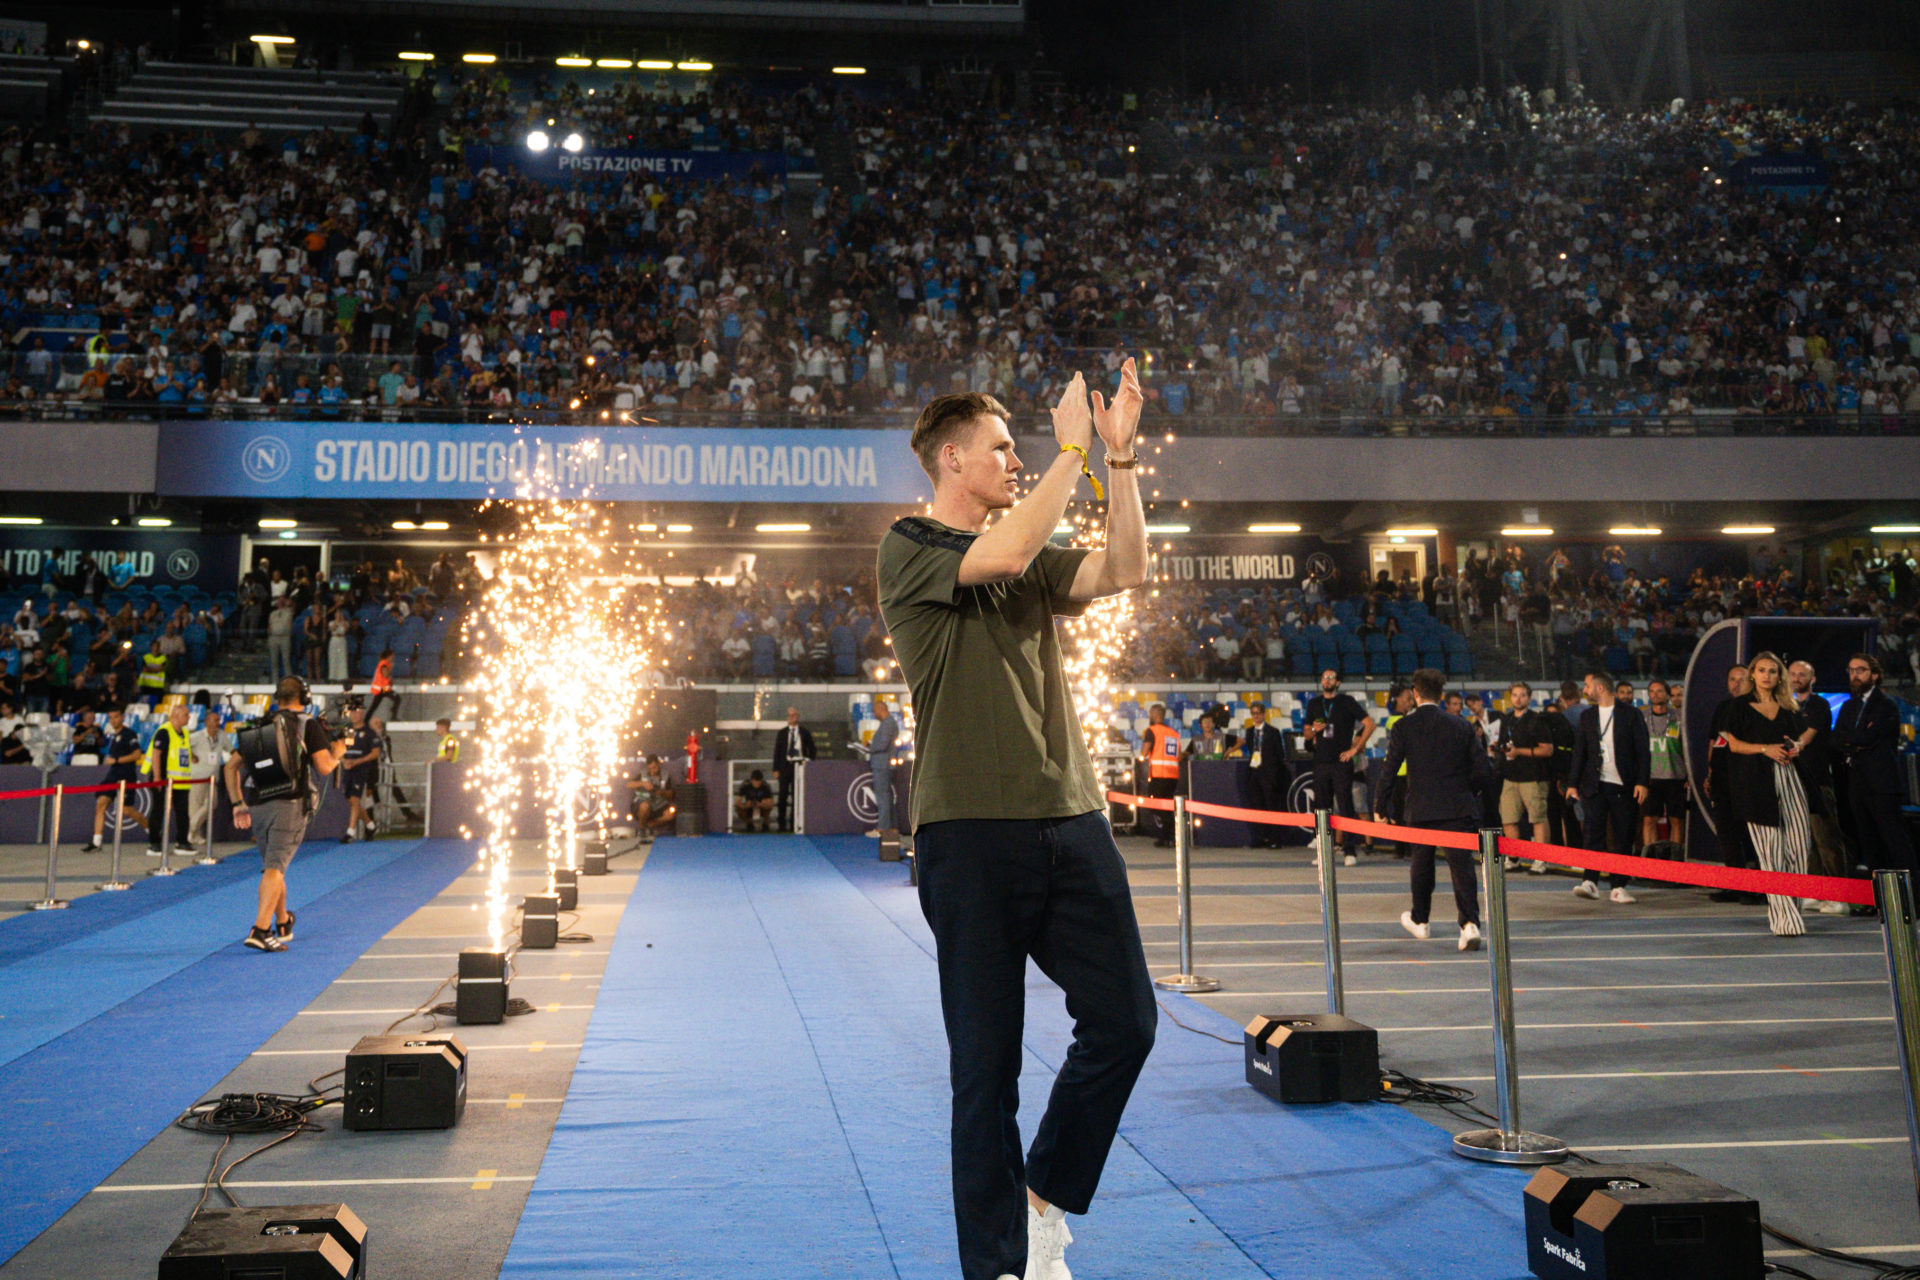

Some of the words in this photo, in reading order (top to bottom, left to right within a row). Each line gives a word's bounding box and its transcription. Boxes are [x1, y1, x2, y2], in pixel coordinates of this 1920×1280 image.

[558, 156, 666, 172] POSTAZIONE
[670, 158, 692, 173] TV
[257, 448, 276, 470] N
[315, 440, 430, 482] STADIO
[437, 441, 529, 484] DIEGO
[534, 443, 693, 486] ARMANDO
[700, 445, 877, 487] MARADONA
[14, 549, 41, 576] TO
[91, 550, 155, 578] WOLD
[176, 558, 189, 573] N
[1171, 555, 1194, 581] TO
[1196, 555, 1231, 580] THE
[1232, 554, 1294, 580] WORLD
[1543, 1237, 1561, 1258] Spark
[1561, 1249, 1586, 1272] Fabrica
